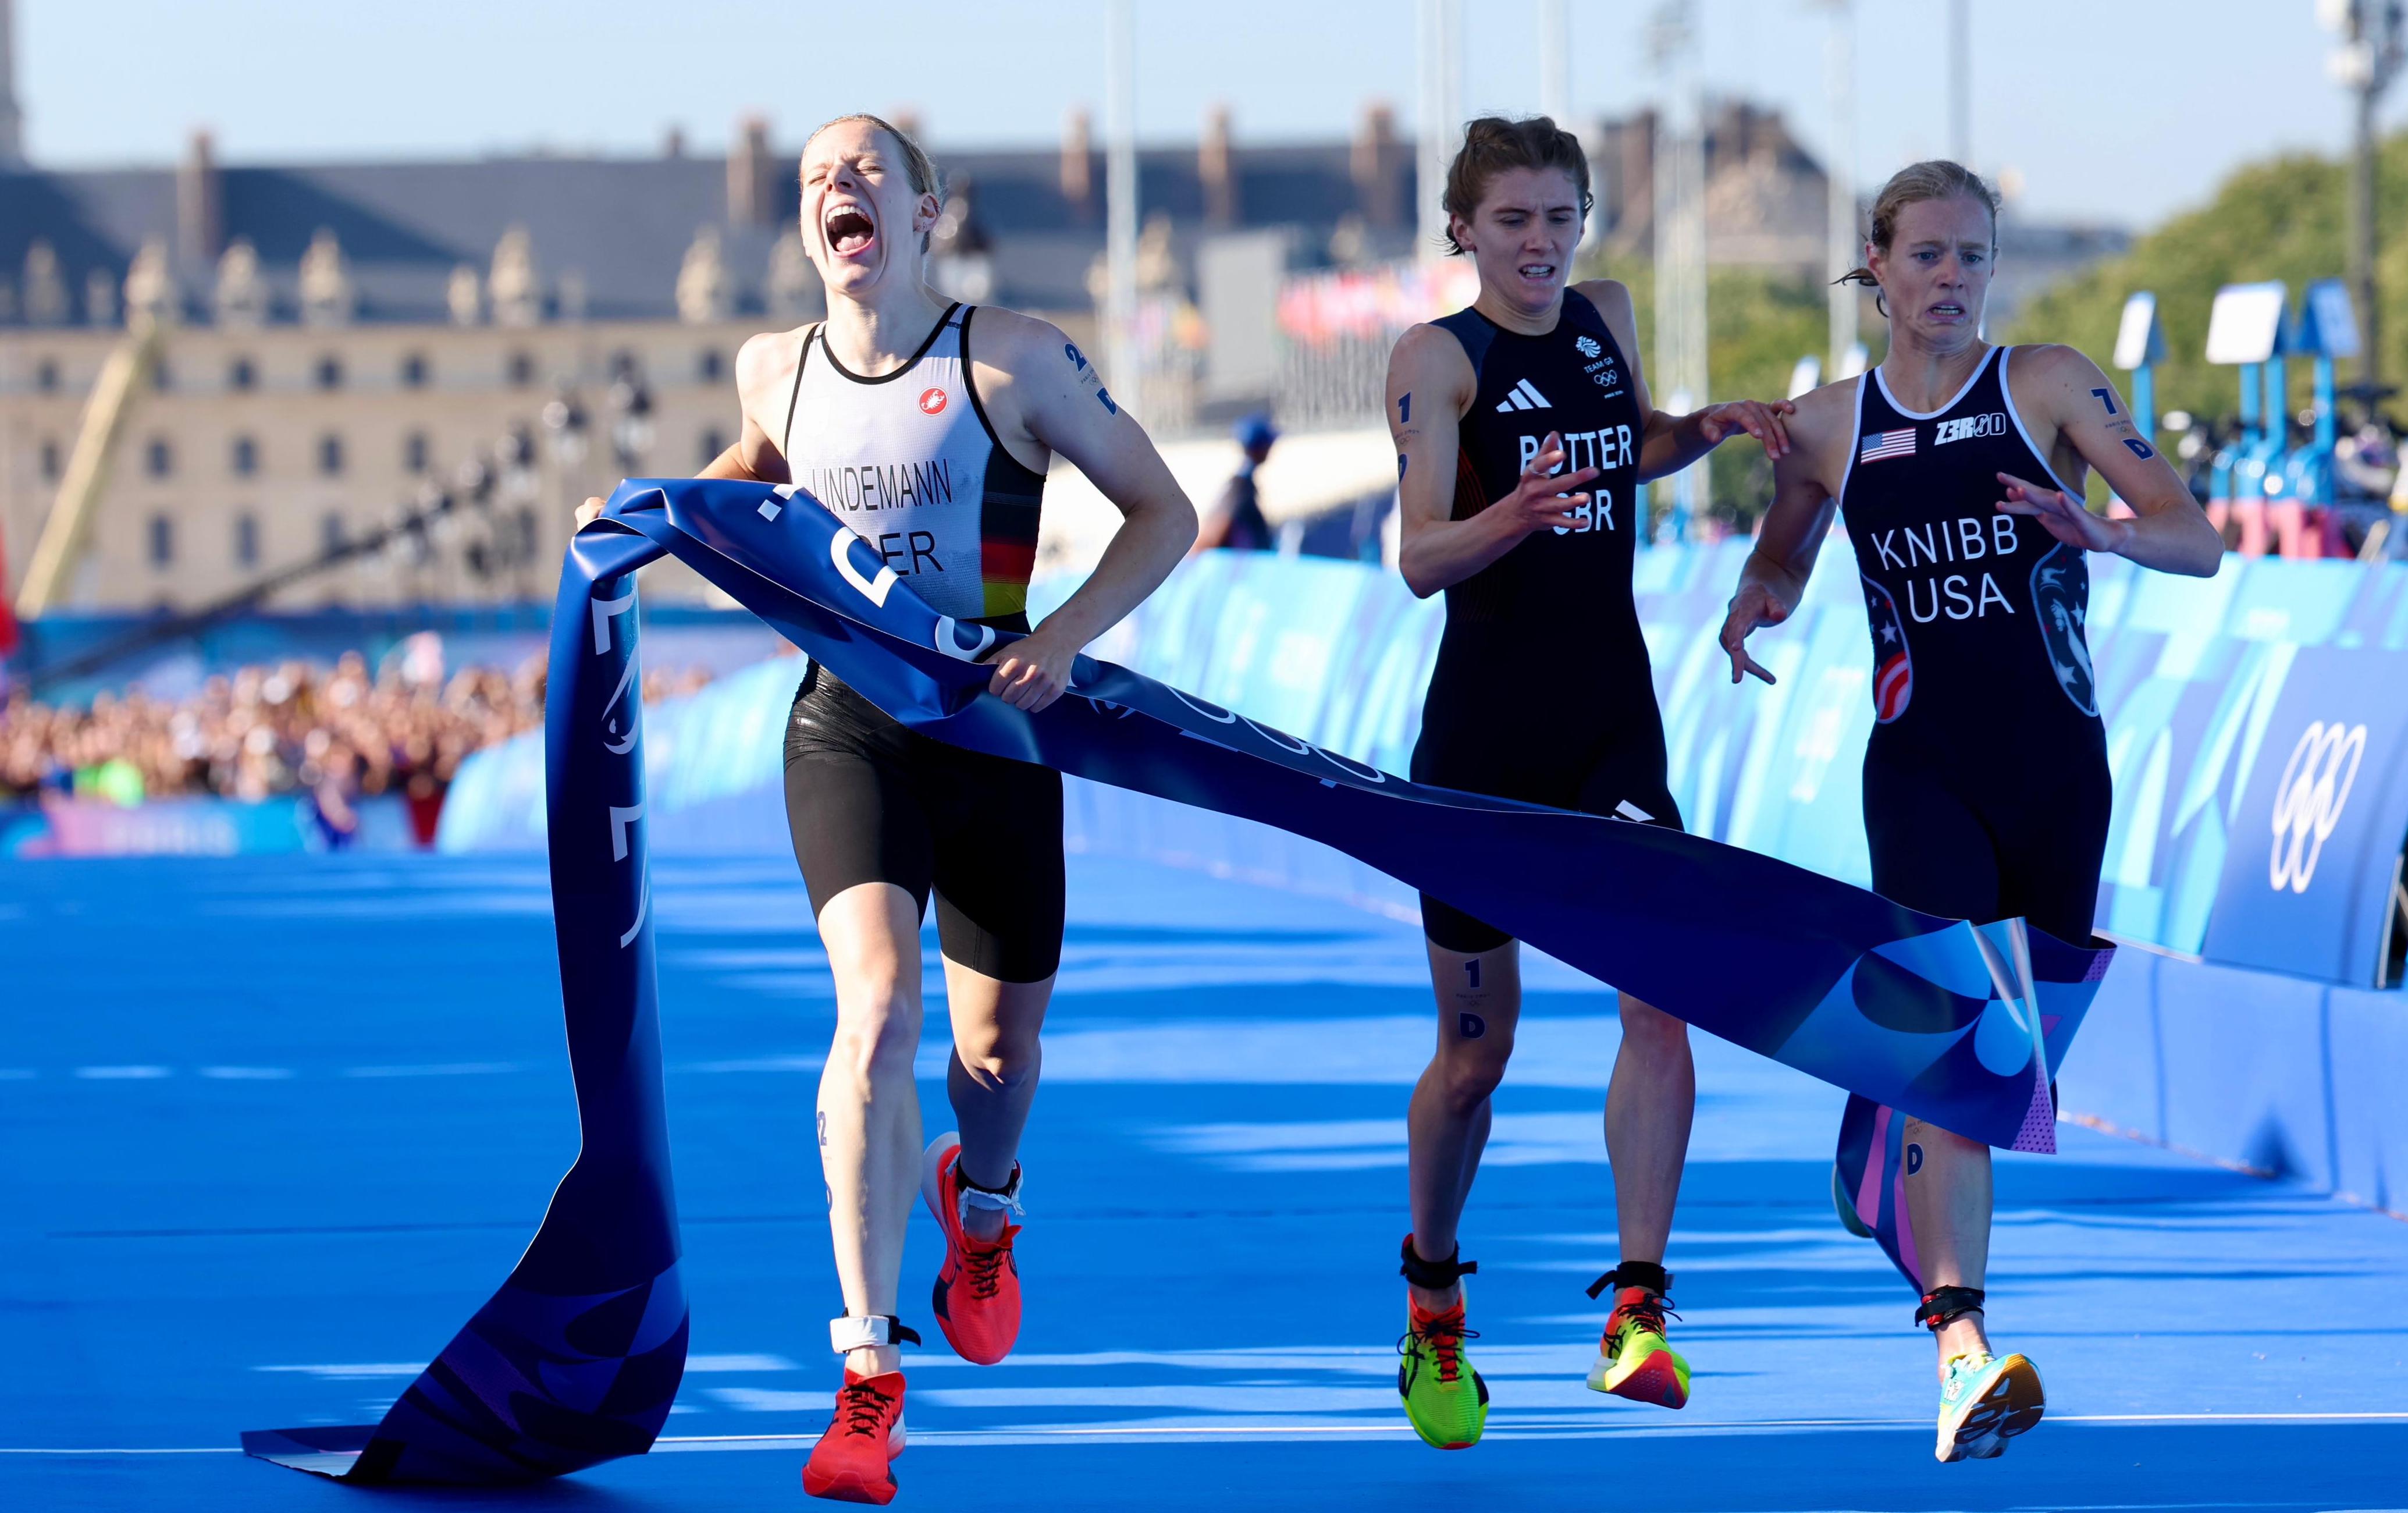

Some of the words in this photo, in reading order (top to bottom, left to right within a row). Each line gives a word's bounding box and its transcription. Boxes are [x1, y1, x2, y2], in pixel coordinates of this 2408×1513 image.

[1065, 343, 1087, 372] 2
[1584, 361, 1605, 373] TEAM
[1604, 357, 1614, 365] GB
[1398, 391, 1411, 424] 1
[2090, 388, 2117, 415] 7
[1520, 424, 1632, 475] POTTER
[2122, 438, 2154, 460] D
[858, 531, 944, 576] ER
[1871, 514, 2018, 570] KNIBB
[1907, 573, 2015, 623] USA
[1464, 958, 1481, 989] 1
[1460, 1012, 1486, 1039] D
[817, 1111, 827, 1146] 2
[1907, 1143, 1923, 1175] D
